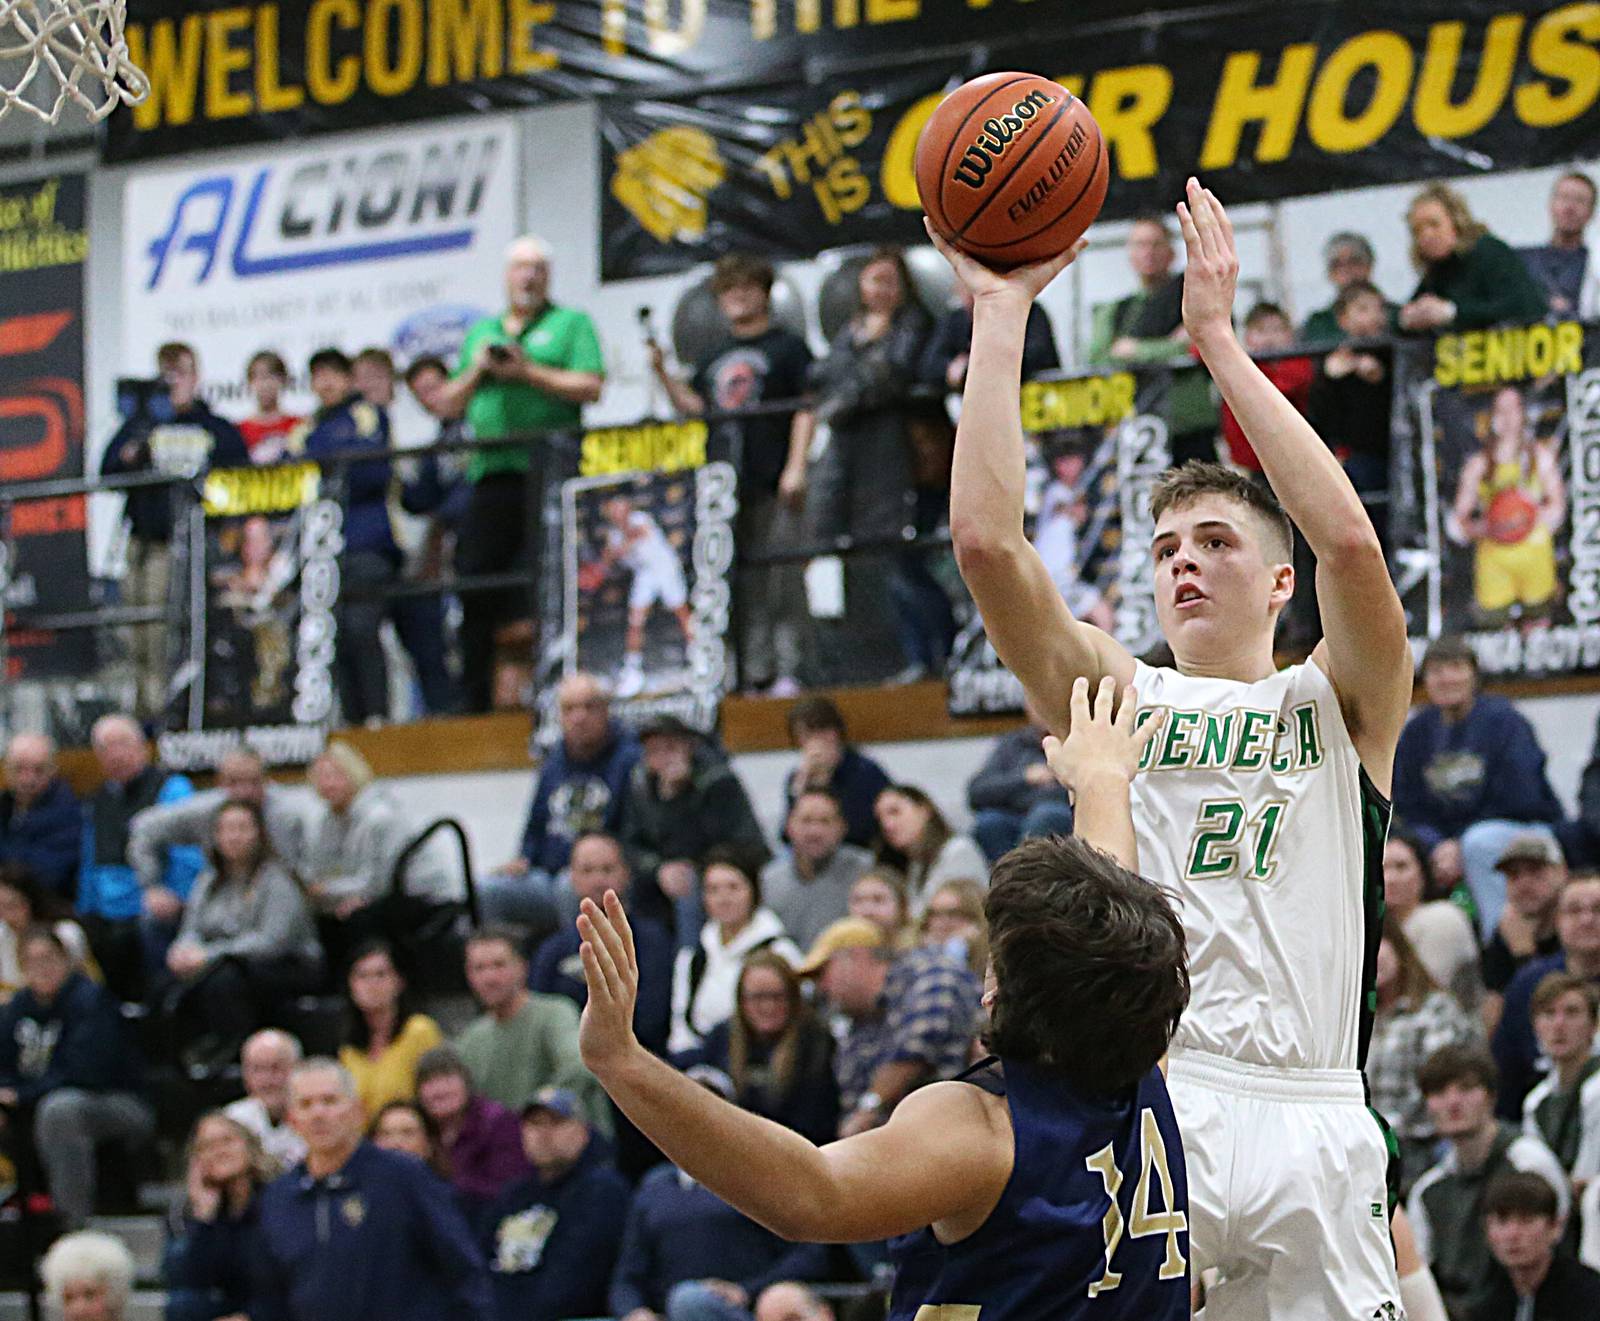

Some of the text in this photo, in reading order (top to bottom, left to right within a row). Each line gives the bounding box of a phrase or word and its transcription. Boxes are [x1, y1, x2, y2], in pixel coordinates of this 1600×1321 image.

[126, 0, 560, 132] WELCOME
[952, 88, 1058, 191] Wilson
[1006, 120, 1092, 224] EVOLUTION
[1433, 320, 1585, 387] SENIOR
[1185, 796, 1289, 882] 21
[1085, 1107, 1188, 1298] 14
